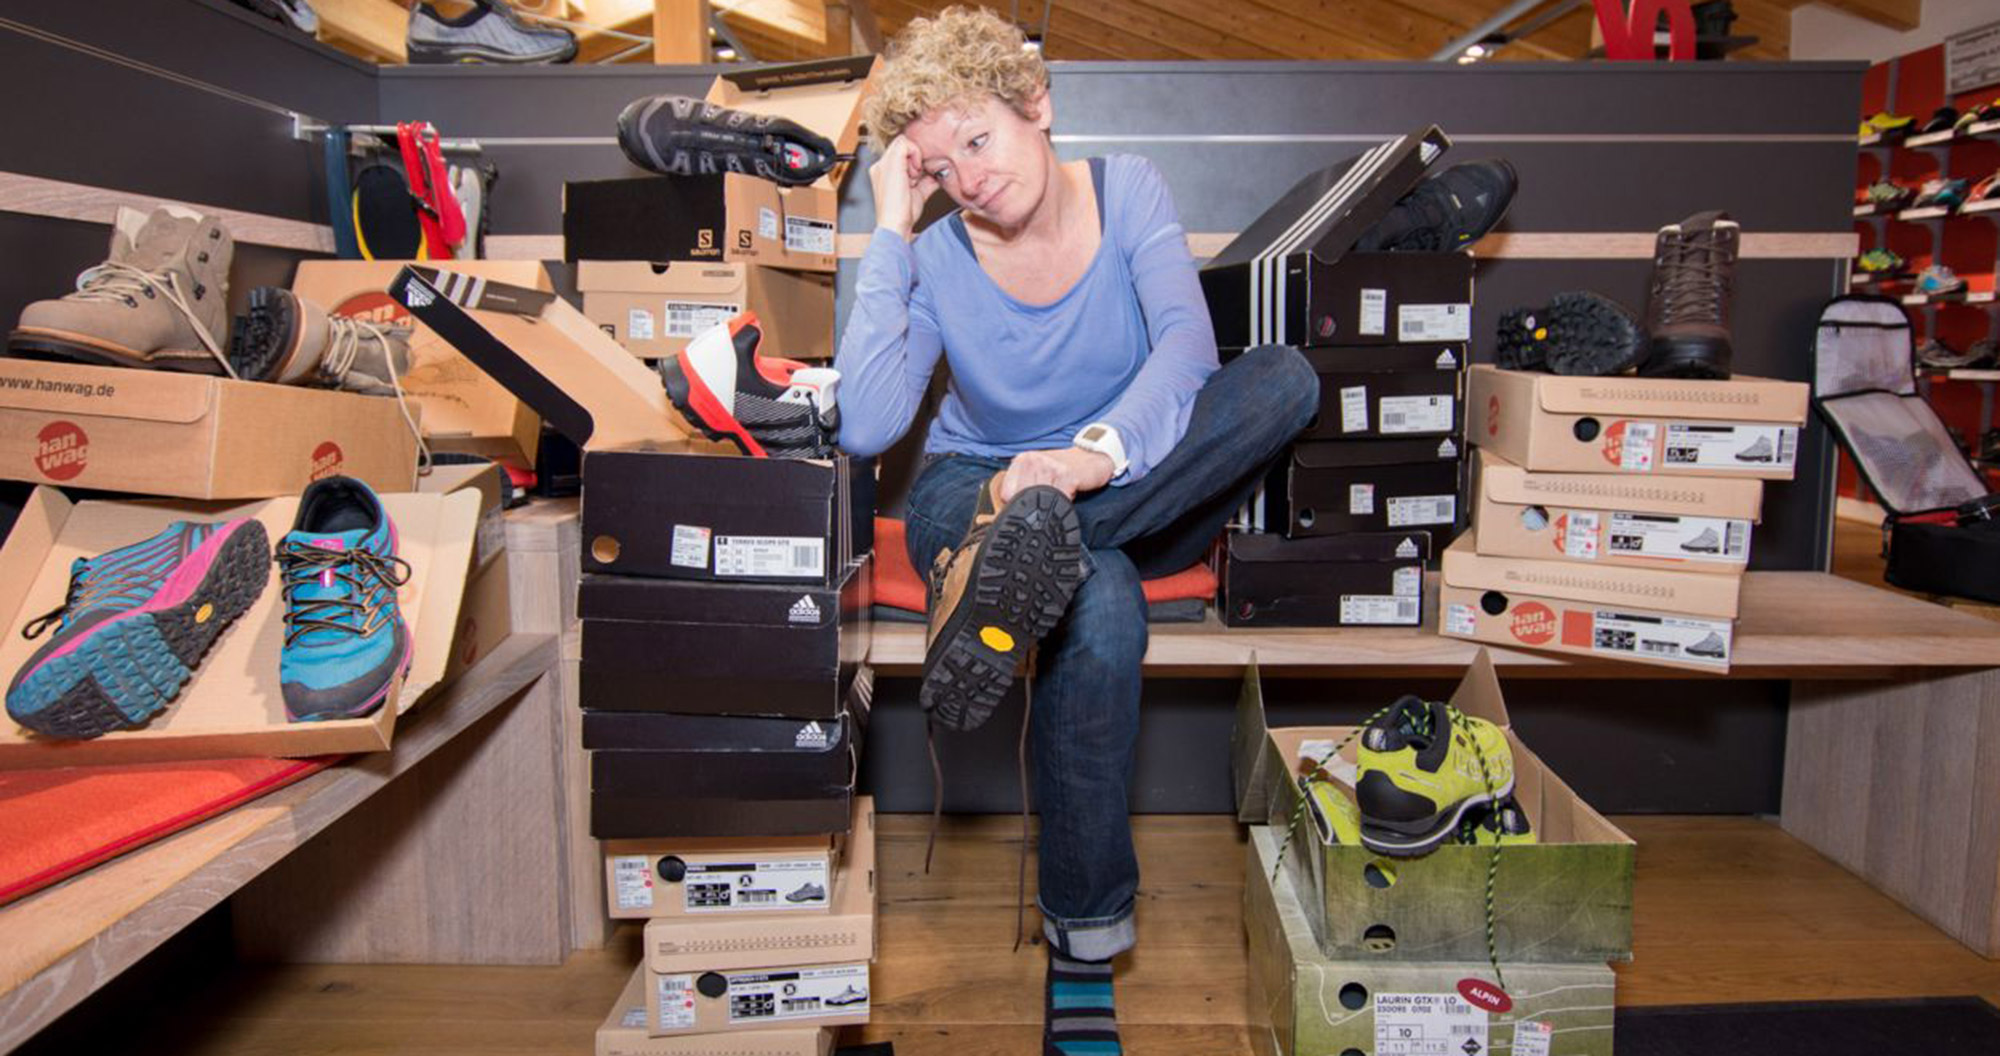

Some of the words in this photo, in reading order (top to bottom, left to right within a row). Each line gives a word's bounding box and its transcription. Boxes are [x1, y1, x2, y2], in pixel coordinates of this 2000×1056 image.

[788, 606, 821, 617] adidas
[1377, 995, 1412, 1004] LAURIN
[1469, 987, 1500, 1006] ALPIN
[1399, 1028, 1412, 1038] 10
